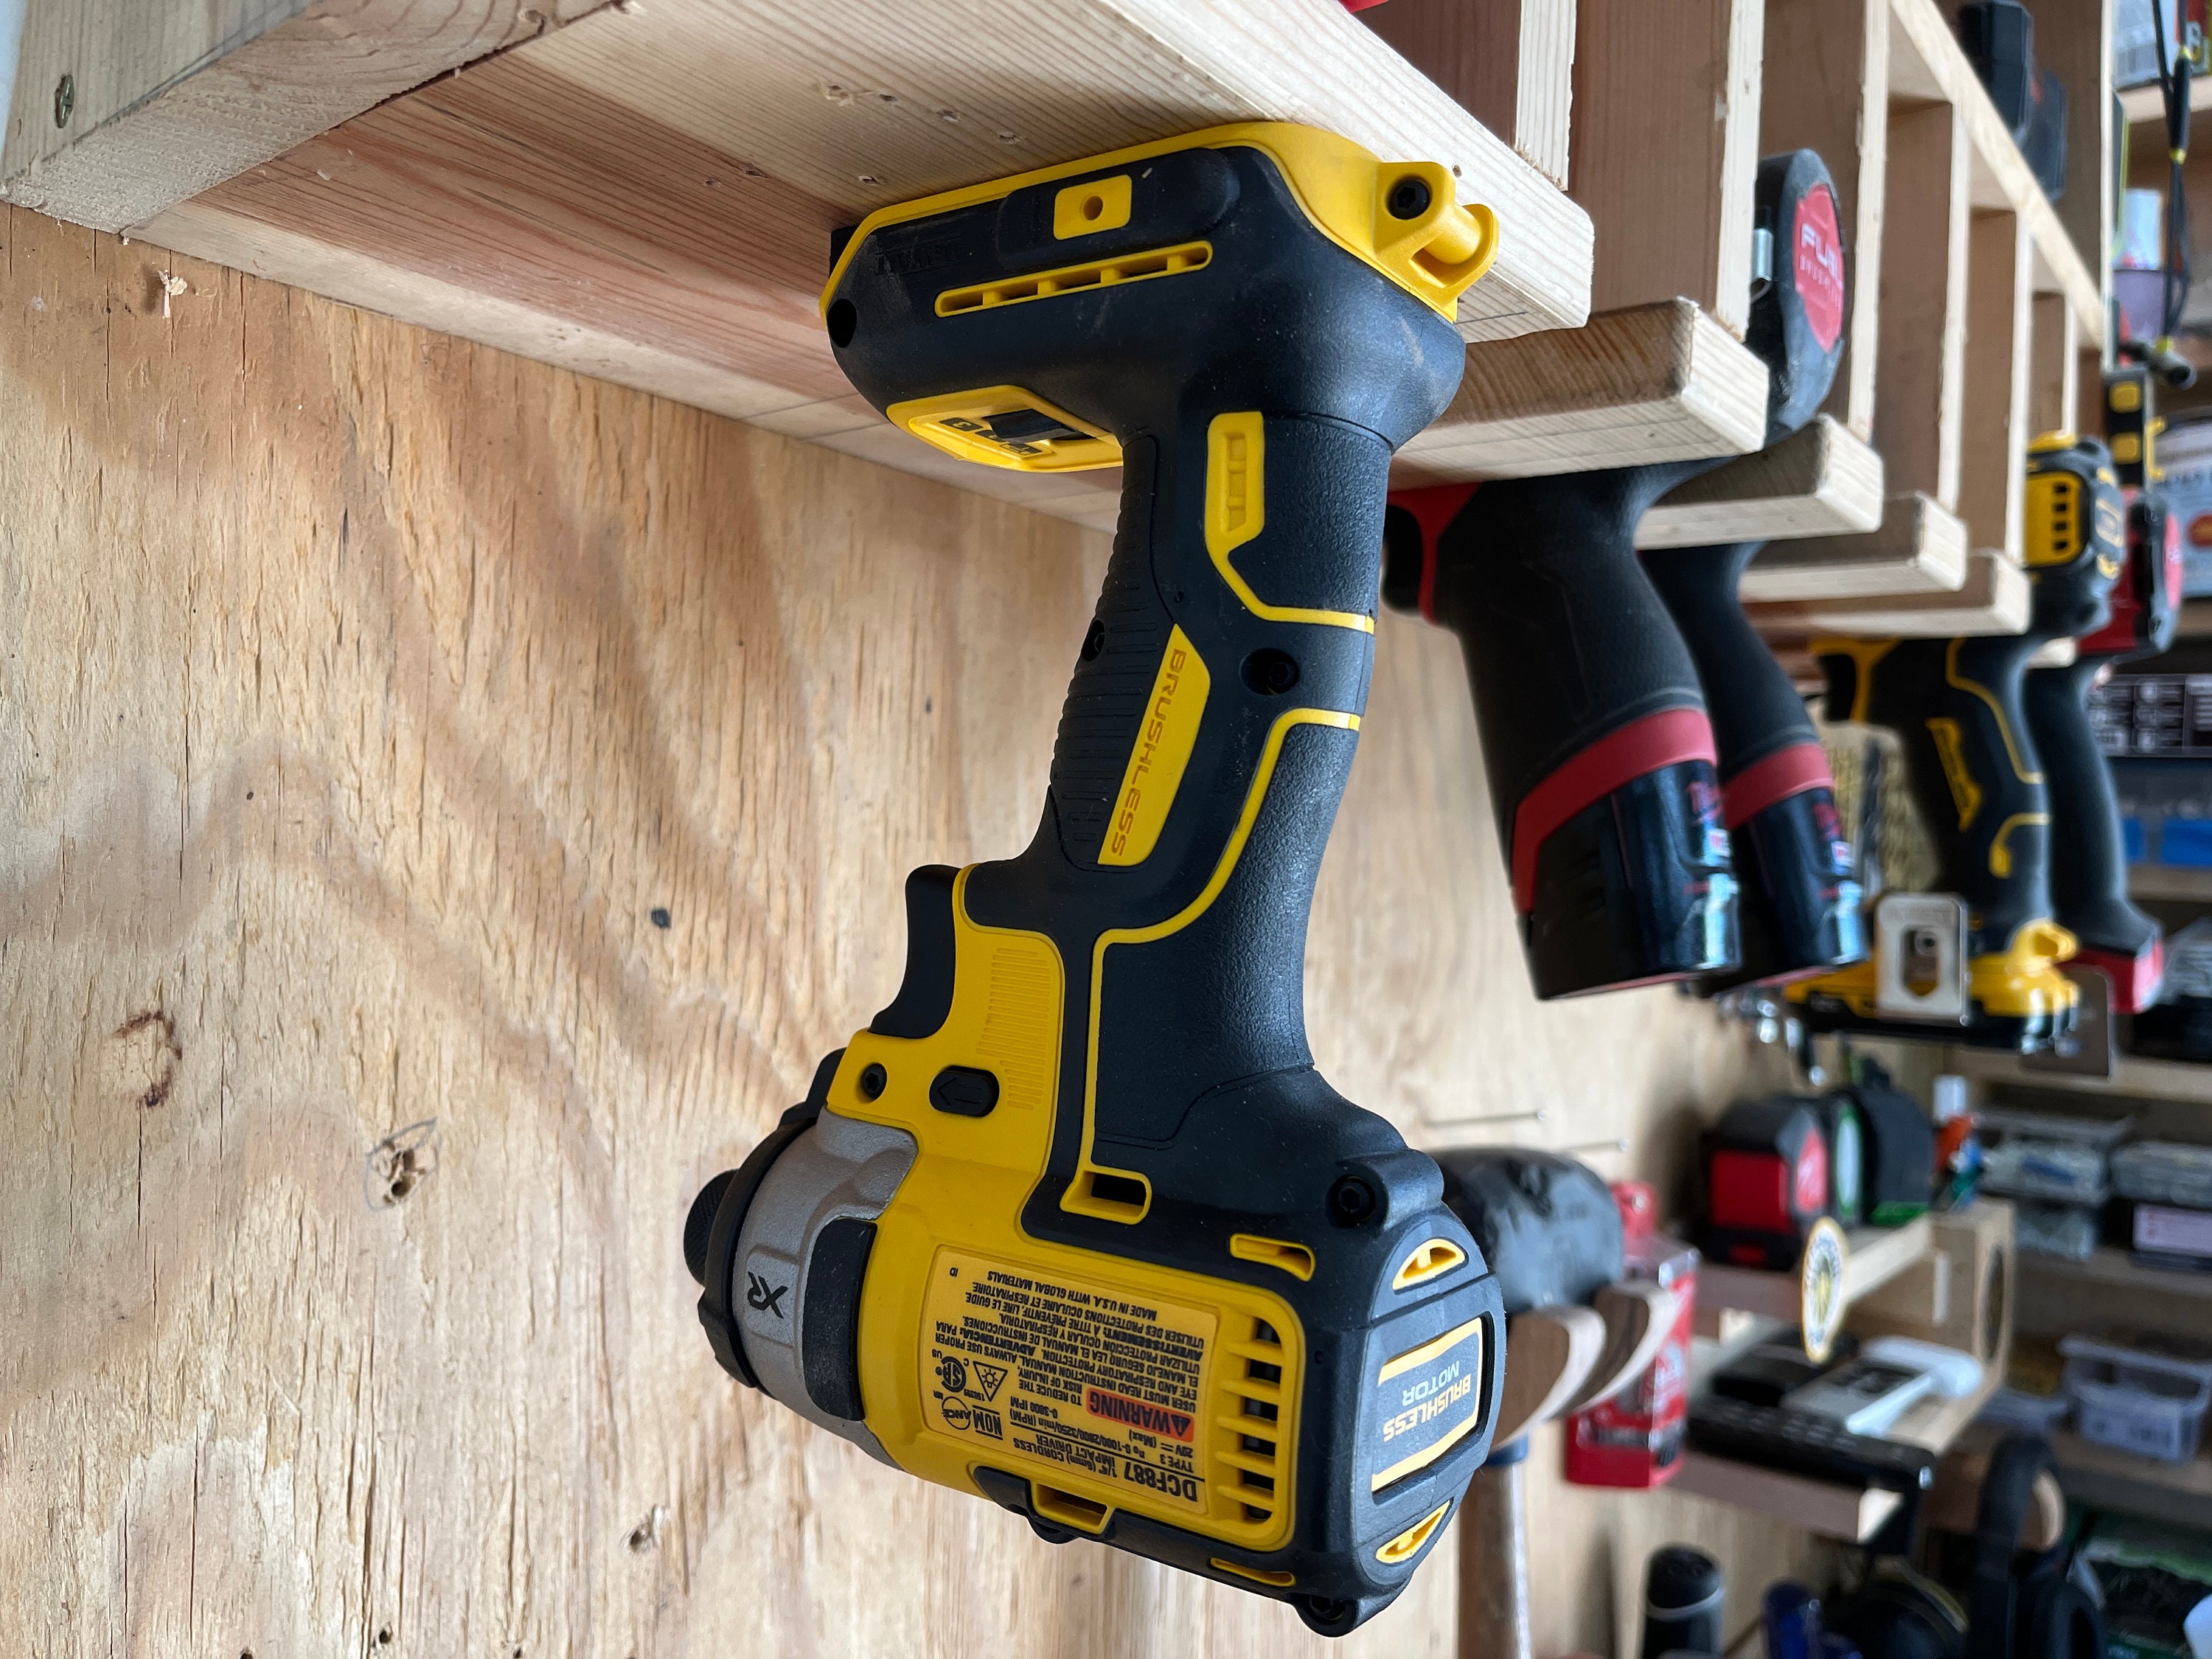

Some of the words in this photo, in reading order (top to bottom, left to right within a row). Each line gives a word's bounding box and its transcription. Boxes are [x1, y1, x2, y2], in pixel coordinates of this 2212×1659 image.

[1111, 648, 1186, 857] BRUSHLESS
[987, 1270, 1033, 1291] MATERIALS
[1034, 1281, 1067, 1298] GLOBAL
[747, 1271, 788, 1319] XR
[991, 1298, 1002, 1310] LE
[1029, 1296, 1042, 1308] ET
[1067, 1290, 1091, 1305] WITH
[1002, 1301, 1020, 1315] LIRE
[1041, 1298, 1083, 1318] OCULAIRE
[1118, 1302, 1130, 1314] IN
[1129, 1304, 1157, 1321] MADE
[936, 1321, 957, 1336] PARA
[962, 1315, 1028, 1342] INSTRUCCIONES.
[998, 1312, 1059, 1338] RESPIRATORIA.
[1068, 1318, 1091, 1334] TITRE
[1084, 1310, 1144, 1334] PROTECTIONS
[1029, 1332, 1040, 1346] DE
[1058, 1329, 1065, 1340] Y
[1067, 1330, 1101, 1349] OCULAR
[1145, 1324, 1164, 1339] DES
[1164, 1329, 1204, 1349] UTILISER
[935, 1332, 965, 1350] PROPER
[959, 1327, 1035, 1356] ADVERTENCIA:
[966, 1340, 983, 1354] USE
[1041, 1336, 1079, 1356] MANUAL
[1102, 1326, 1203, 1361] AVERTISSEMENT:
[931, 1349, 943, 1360] US
[984, 1346, 1018, 1363] ALWAYS
[1041, 1349, 1096, 1373] PROTECTION.
[1079, 1346, 1090, 1359] EL
[1091, 1349, 1107, 1364] LEA
[1159, 1354, 1200, 1375] UTILIZAR
[1017, 1366, 1049, 1385] INJURY,
[1049, 1376, 1061, 1388] OF
[1058, 1366, 1116, 1391] INSTRUCTION
[1096, 1364, 1156, 1389] RESPIRATORY
[1146, 1364, 1186, 1384] MANEJO
[1187, 1374, 1198, 1388] EL
[1402, 1360, 1460, 1406] MOTOR
[1018, 1379, 1034, 1393] THE
[1035, 1383, 1068, 1402] REDUCE
[1062, 1379, 1082, 1394] RISK
[1117, 1382, 1141, 1398] READ
[1158, 1380, 1178, 1395] AND
[1179, 1386, 1197, 1401] EYE
[1010, 1395, 1028, 1411] IPM
[1070, 1394, 1082, 1406] TO
[1143, 1389, 1169, 1406] MUST
[1172, 1397, 1196, 1413] USER
[1090, 1391, 1172, 1433] WARNING
[1382, 1374, 1472, 1442] BRUSHLESS
[972, 1409, 1003, 1436] NOM
[1009, 1408, 1037, 1427] (RPM)
[1035, 1433, 1073, 1455] DRIVER
[1128, 1429, 1157, 1449] (Max)
[1012, 1437, 1065, 1462] CORDLESS
[1074, 1446, 1116, 1467] IMPACT
[1175, 1444, 1193, 1458] 20V
[1159, 1453, 1166, 1465] 3
[1167, 1455, 1194, 1473] TYPE
[1124, 1461, 1197, 1502] DCF887
